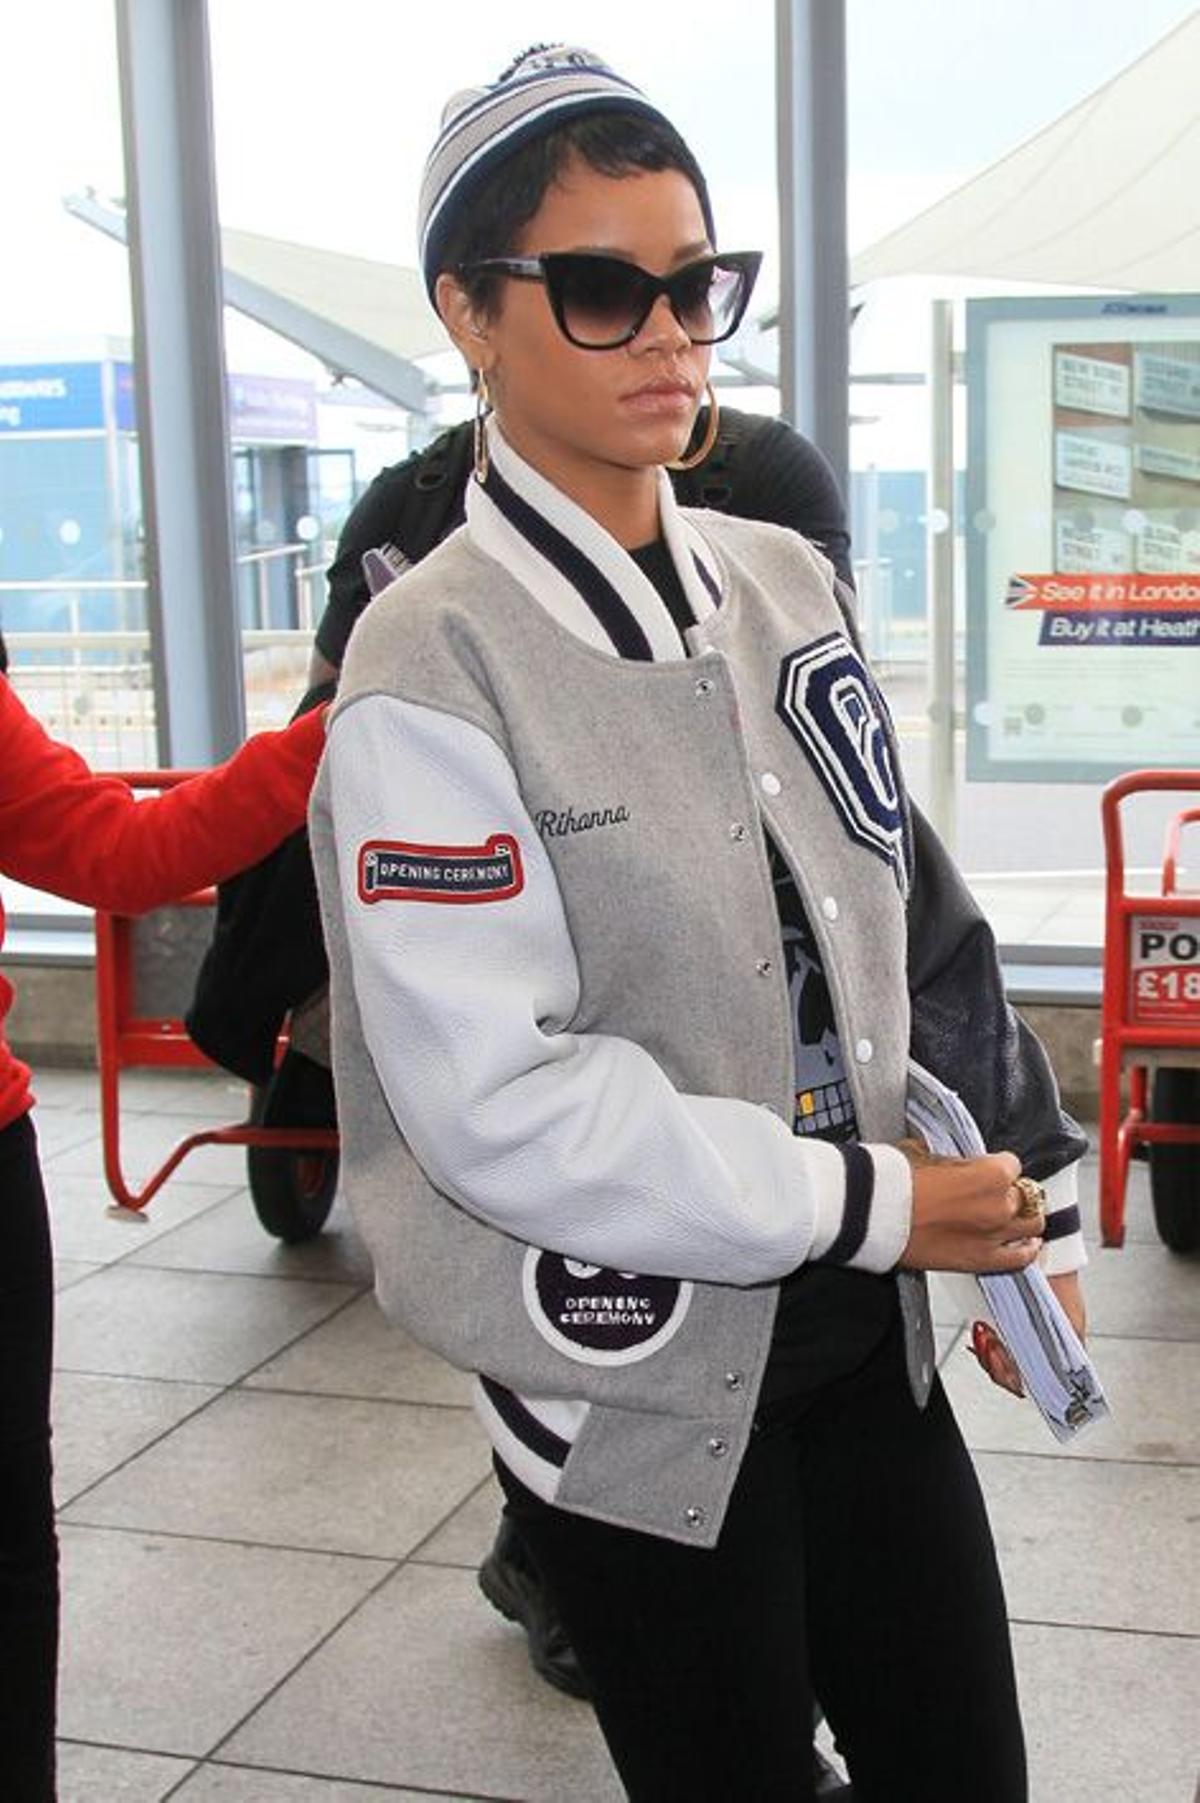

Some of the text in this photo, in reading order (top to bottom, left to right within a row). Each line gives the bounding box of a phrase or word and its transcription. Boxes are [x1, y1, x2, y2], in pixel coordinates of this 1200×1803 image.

[1043, 582, 1085, 600] See
[1089, 582, 1104, 600] it
[1106, 581, 1125, 600] in
[1051, 617, 1092, 640] Buy
[1095, 617, 1110, 636] it
[1112, 617, 1135, 636] at
[536, 805, 631, 837] Rihanna
[380, 863, 509, 882] OPENING CEREMONY
[1140, 933, 1200, 961] PO
[565, 1296, 651, 1310] OPENING
[560, 1311, 656, 1325] CEREMONY
